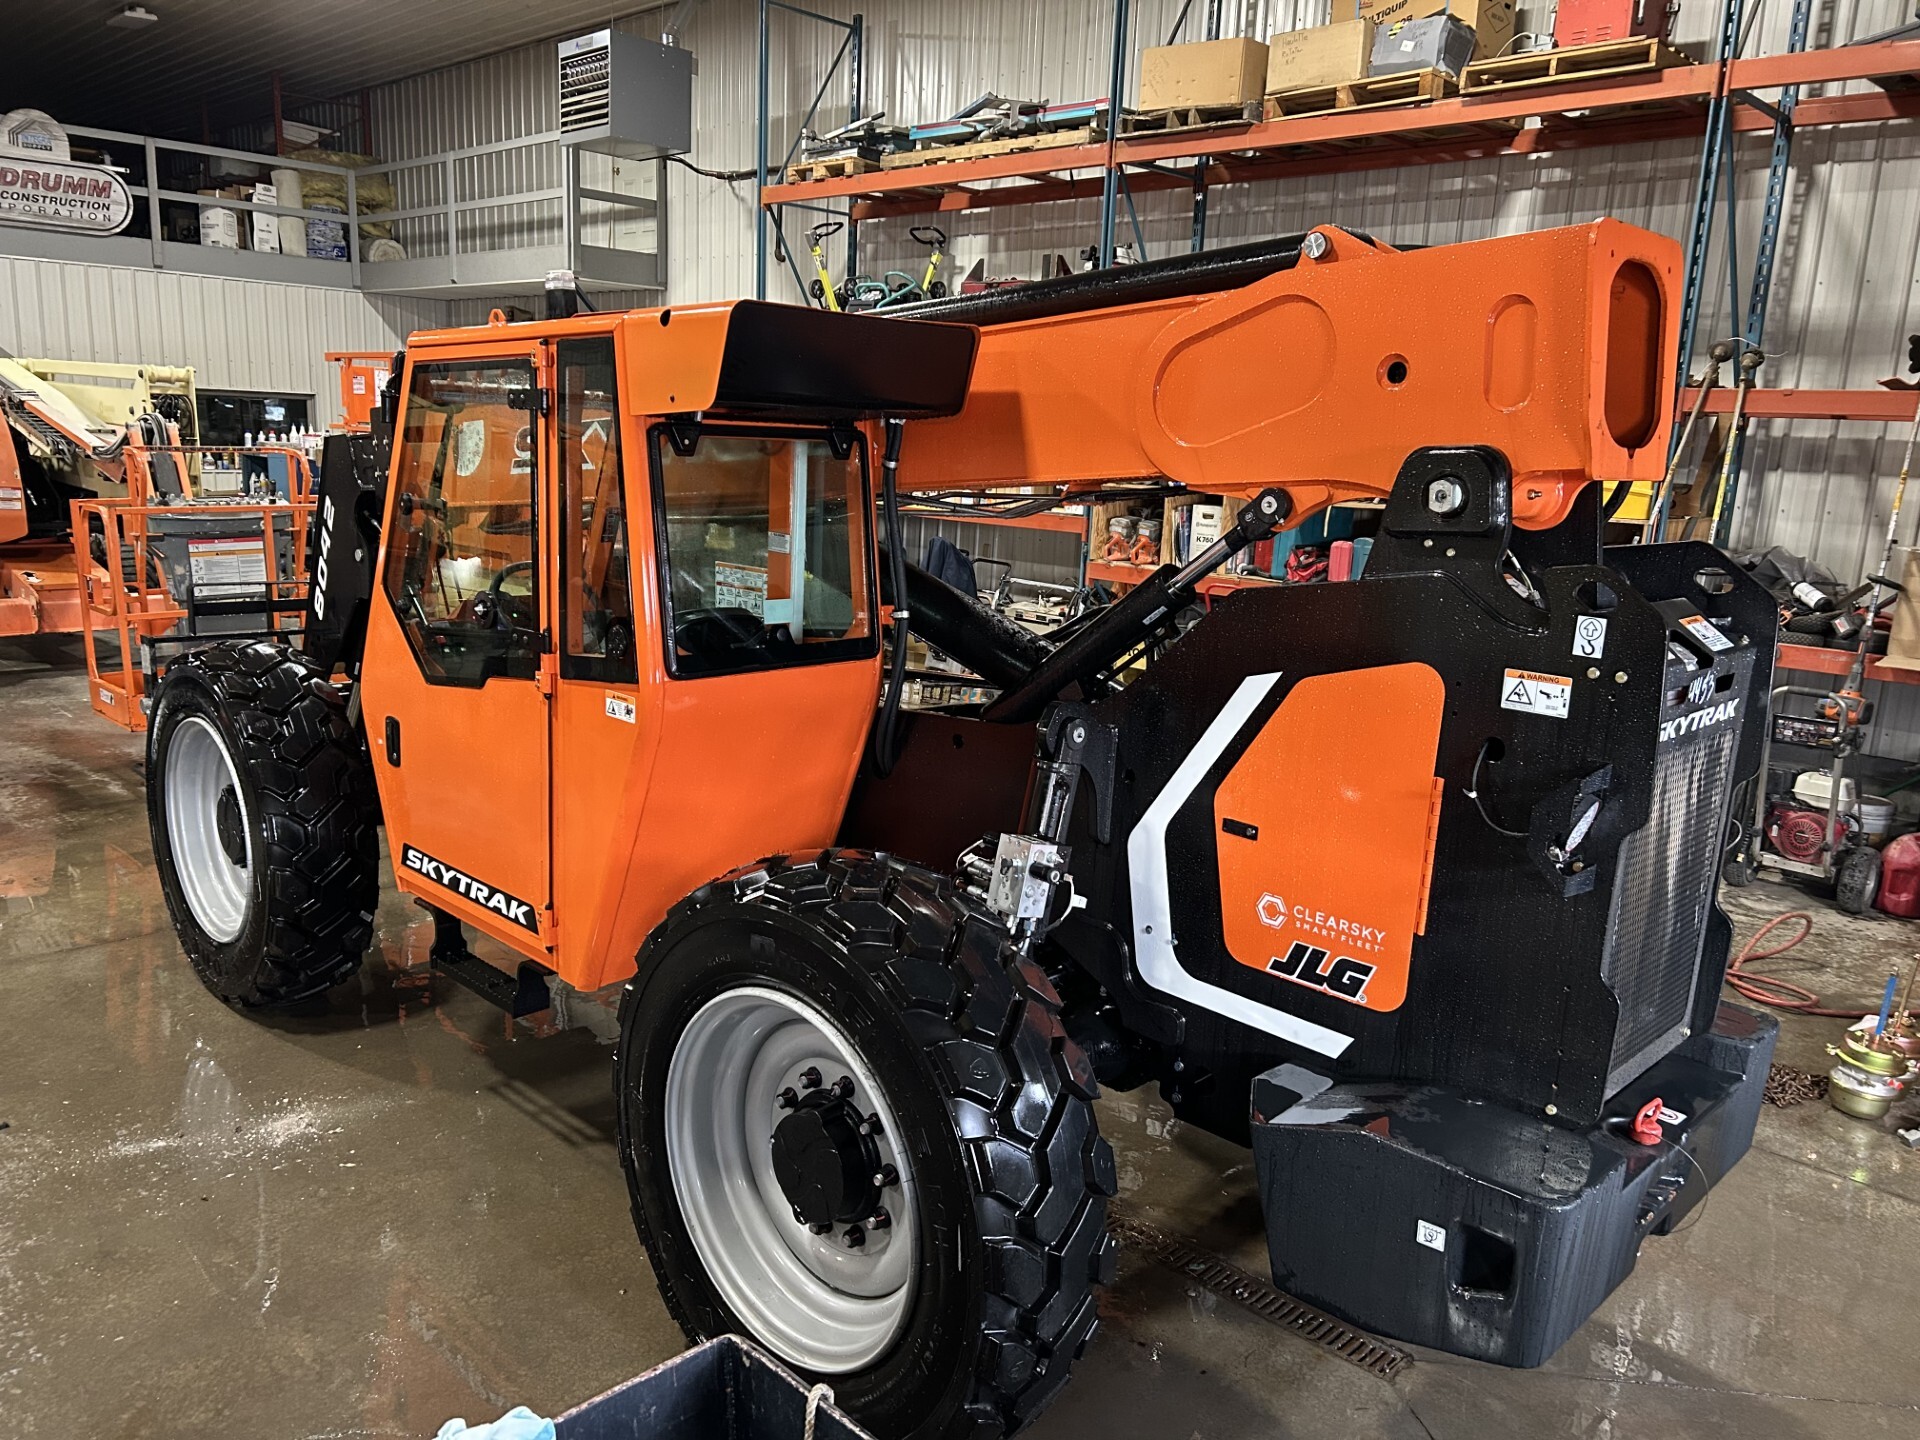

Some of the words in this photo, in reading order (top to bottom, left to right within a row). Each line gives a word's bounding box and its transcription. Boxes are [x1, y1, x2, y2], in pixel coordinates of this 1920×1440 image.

[1360, 0, 1408, 22] LTIQUIP
[0, 167, 112, 199] DRUMM
[0, 191, 111, 211] CONSTRUCTION
[0, 203, 111, 222] PORATION
[314, 495, 335, 620] 8042
[1526, 673, 1560, 684] WARNING
[406, 848, 530, 925] SKYTRAK
[1293, 905, 1386, 943] CLEARSKY
[1295, 921, 1336, 939] SMART
[1265, 940, 1377, 1001] JLG
